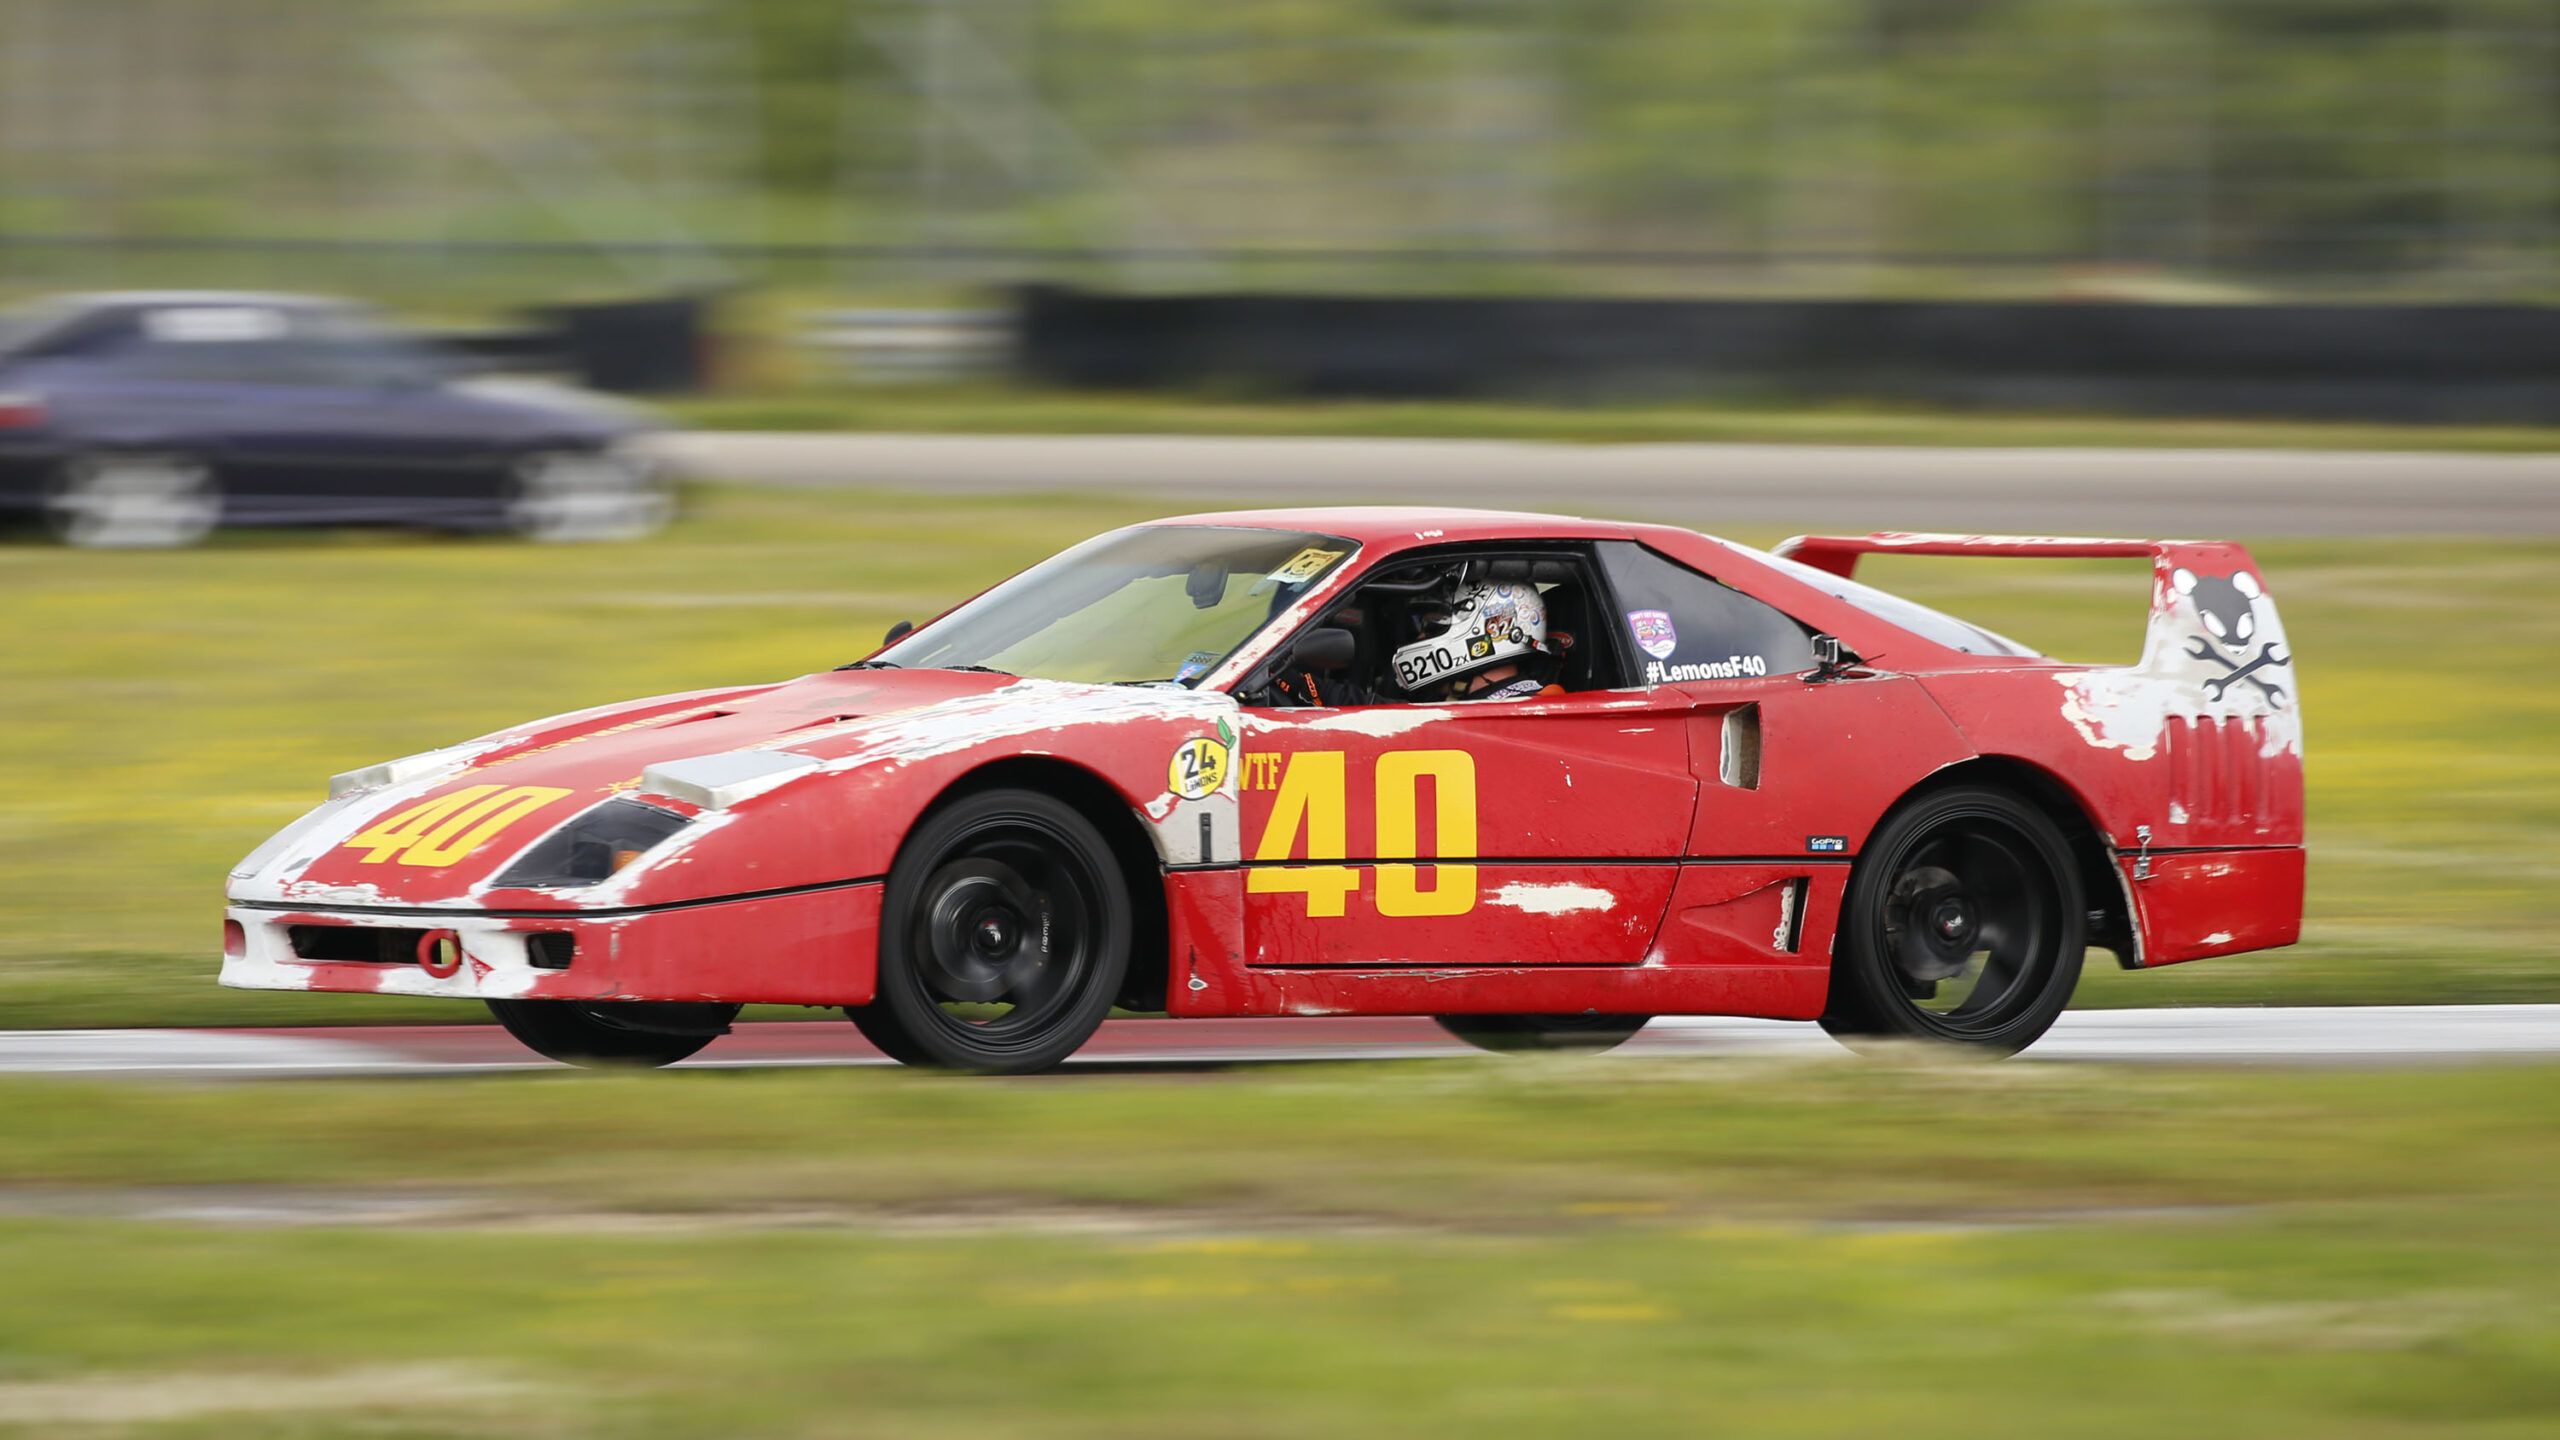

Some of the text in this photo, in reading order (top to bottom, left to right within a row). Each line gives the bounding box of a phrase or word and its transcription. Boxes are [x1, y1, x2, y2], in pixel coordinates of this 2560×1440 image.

[1399, 648, 1453, 684] B210
[1646, 655, 1766, 682] #LemonsF40
[1181, 743, 1216, 779] 24
[342, 784, 575, 867] 40
[1247, 749, 1477, 917] 40
